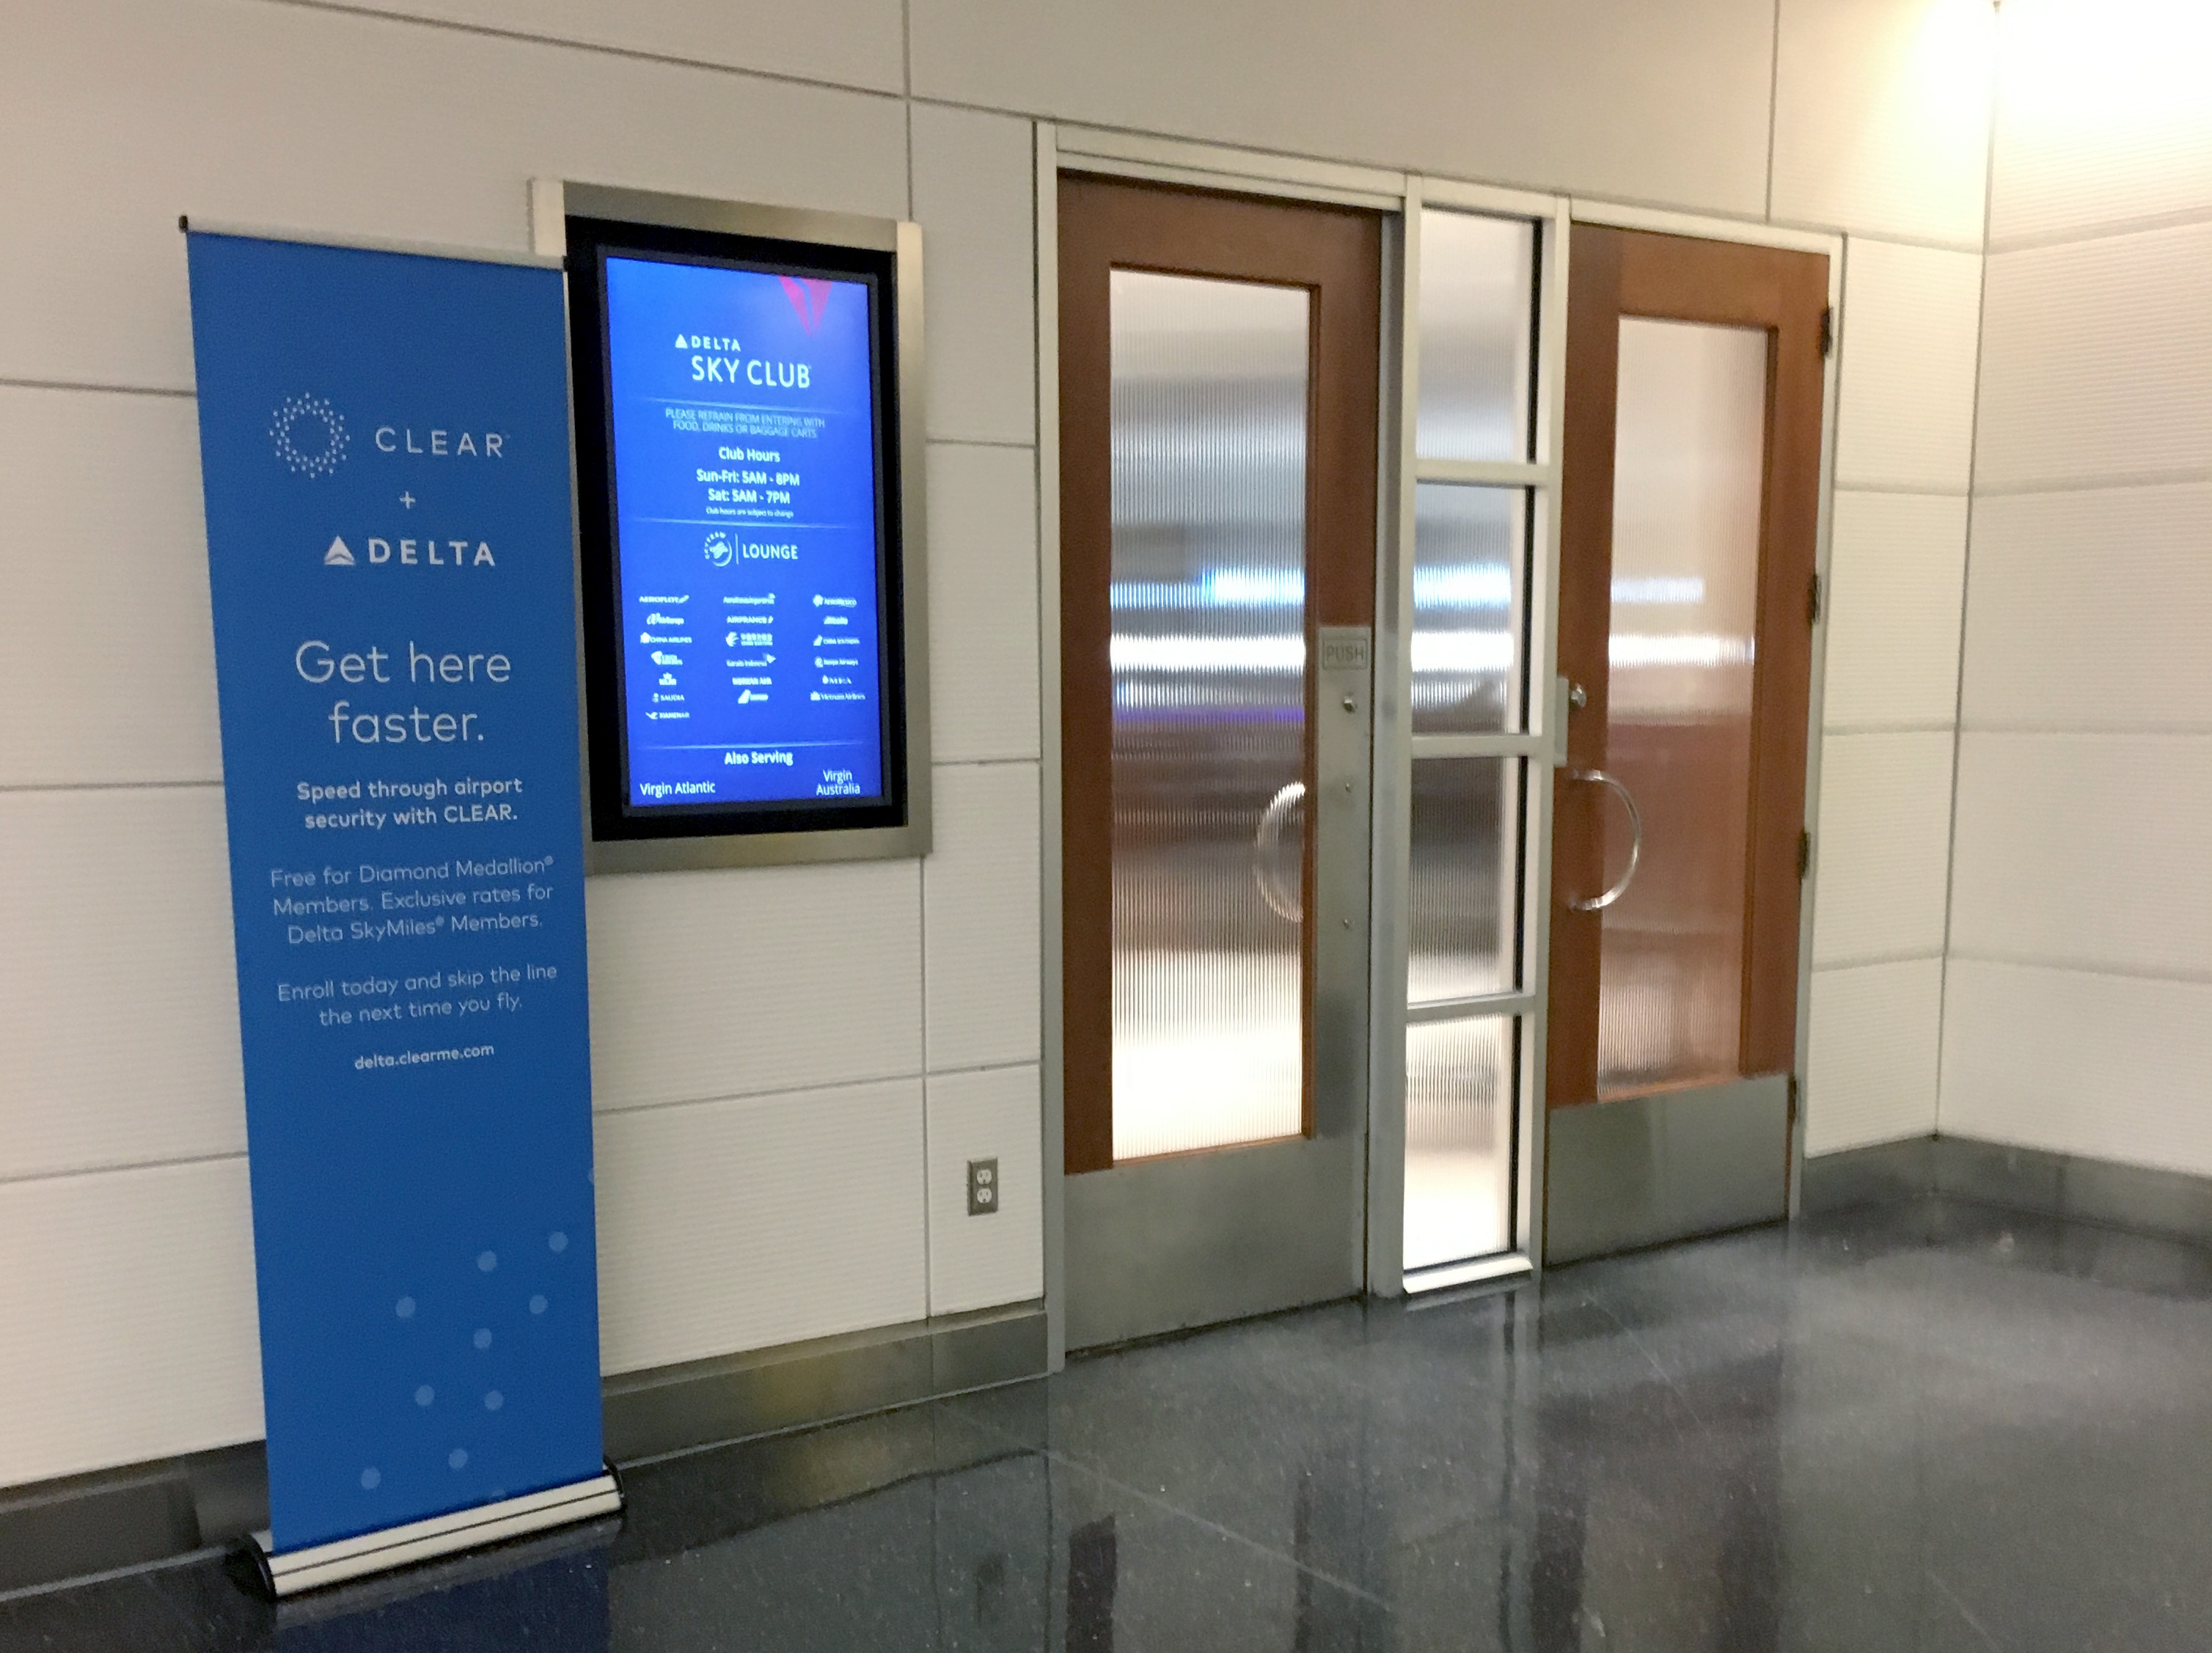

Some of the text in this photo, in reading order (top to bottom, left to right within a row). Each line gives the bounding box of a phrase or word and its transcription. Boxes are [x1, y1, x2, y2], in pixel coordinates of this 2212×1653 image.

[691, 335, 741, 352] DELTA
[691, 355, 810, 388] SKY CLUB
[665, 407, 825, 428] PLEASE REFRAIN FROM ENTERING WITH
[703, 421, 733, 433] DRINKS
[736, 423, 747, 433] OR
[750, 424, 788, 436] BAGGAGE
[791, 427, 817, 439] CARTS
[375, 427, 503, 458] CLEAR
[719, 446, 780, 463] Club Hours
[696, 468, 739, 483] Sun-Fri:
[741, 470, 767, 485] 5AM
[776, 472, 800, 485] 8PM
[708, 488, 730, 502] Sat:
[731, 488, 757, 502] 5AM
[766, 490, 790, 504] 7PM
[368, 538, 496, 566] DELTA
[742, 543, 798, 560] LOUNGE
[296, 640, 511, 683] Get here
[1327, 645, 1363, 661] PUSH
[328, 699, 484, 743] faster.
[725, 750, 794, 766] Also Serving
[640, 780, 716, 798] Virgin Atlantic
[816, 782, 860, 796] Australia
[823, 769, 852, 784] Virgin
[297, 777, 523, 804] Speed through airport
[304, 804, 518, 830] security with CLEAR.
[271, 868, 316, 888] Free
[323, 865, 352, 885] for
[360, 862, 449, 884] Diamond
[274, 883, 554, 917] Members. Exclusive rates for
[288, 924, 343, 945] Delta
[451, 912, 543, 933] Members.
[278, 964, 557, 1002] Enroll today and skip the line
[319, 992, 523, 1027] the next time you fly.
[354, 1044, 495, 1070] delta.clearme.com
